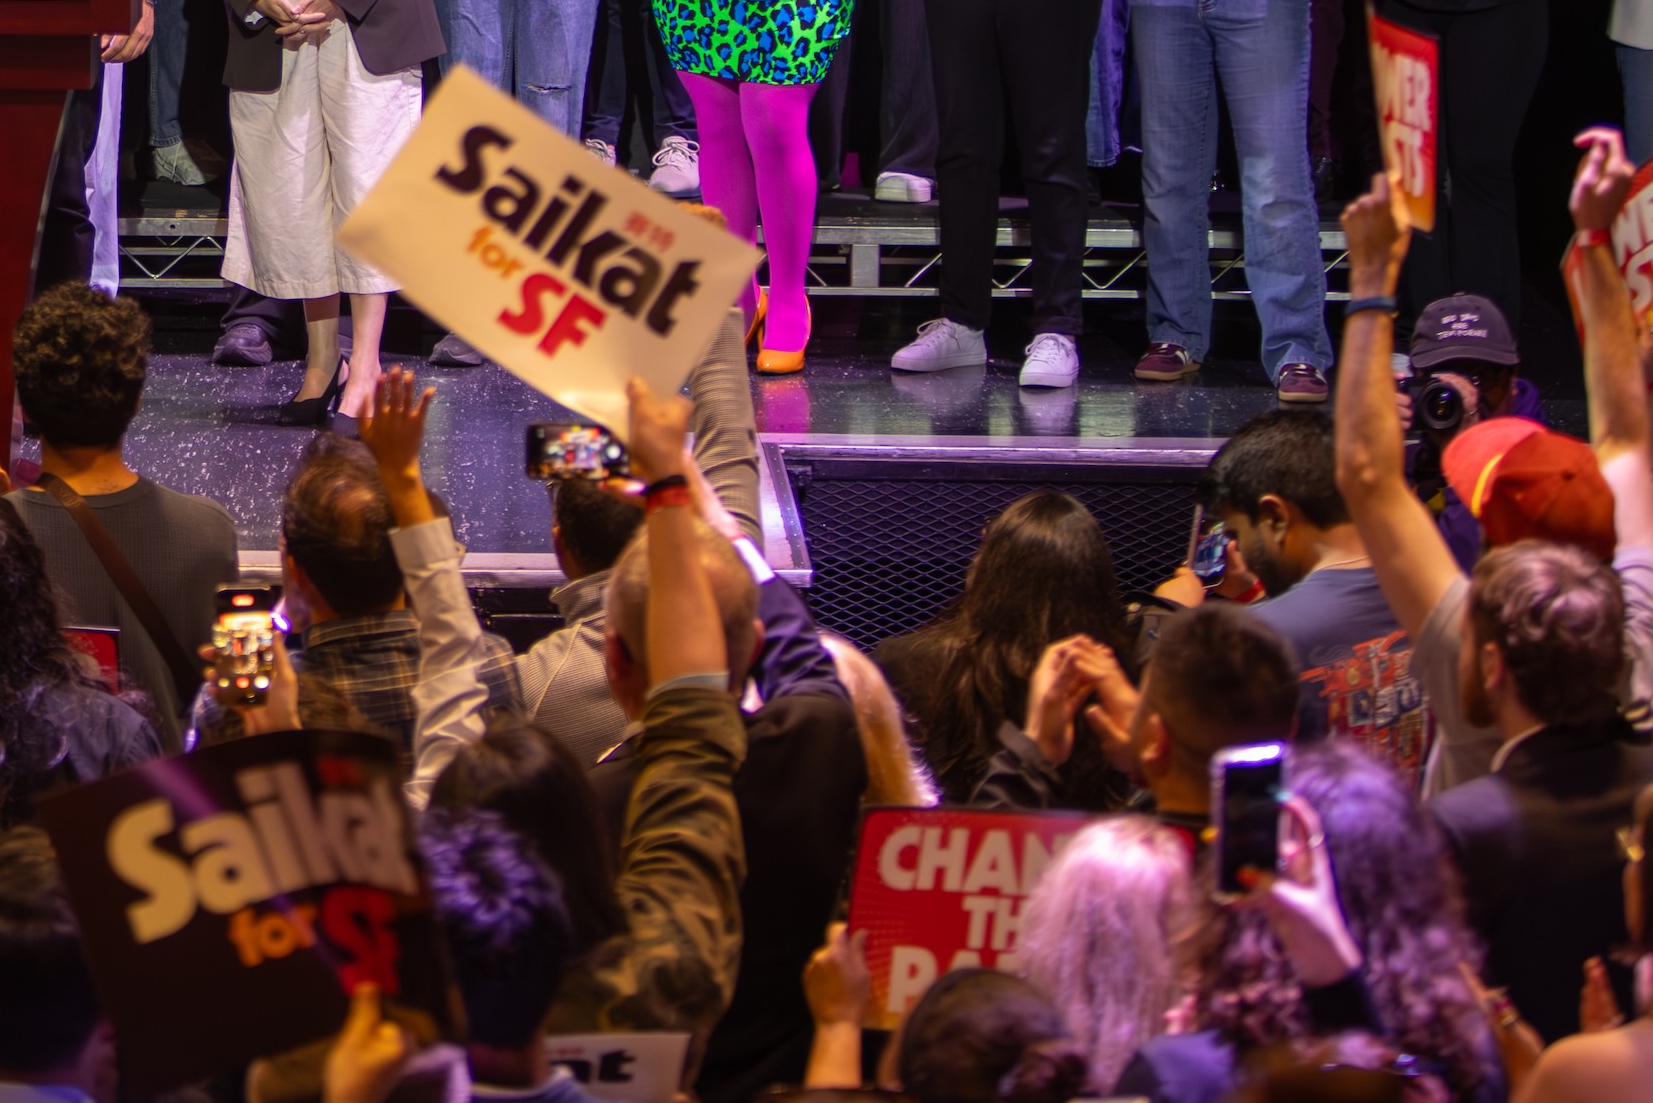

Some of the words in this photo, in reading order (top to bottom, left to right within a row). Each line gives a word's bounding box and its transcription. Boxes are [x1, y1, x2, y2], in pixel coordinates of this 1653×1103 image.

[433, 124, 702, 339] Saikat
[466, 225, 524, 280] for
[496, 272, 608, 359] SF
[106, 760, 419, 945] Saikat
[878, 824, 1073, 895] CHAN
[229, 904, 318, 968] for
[961, 896, 1028, 951] TH
